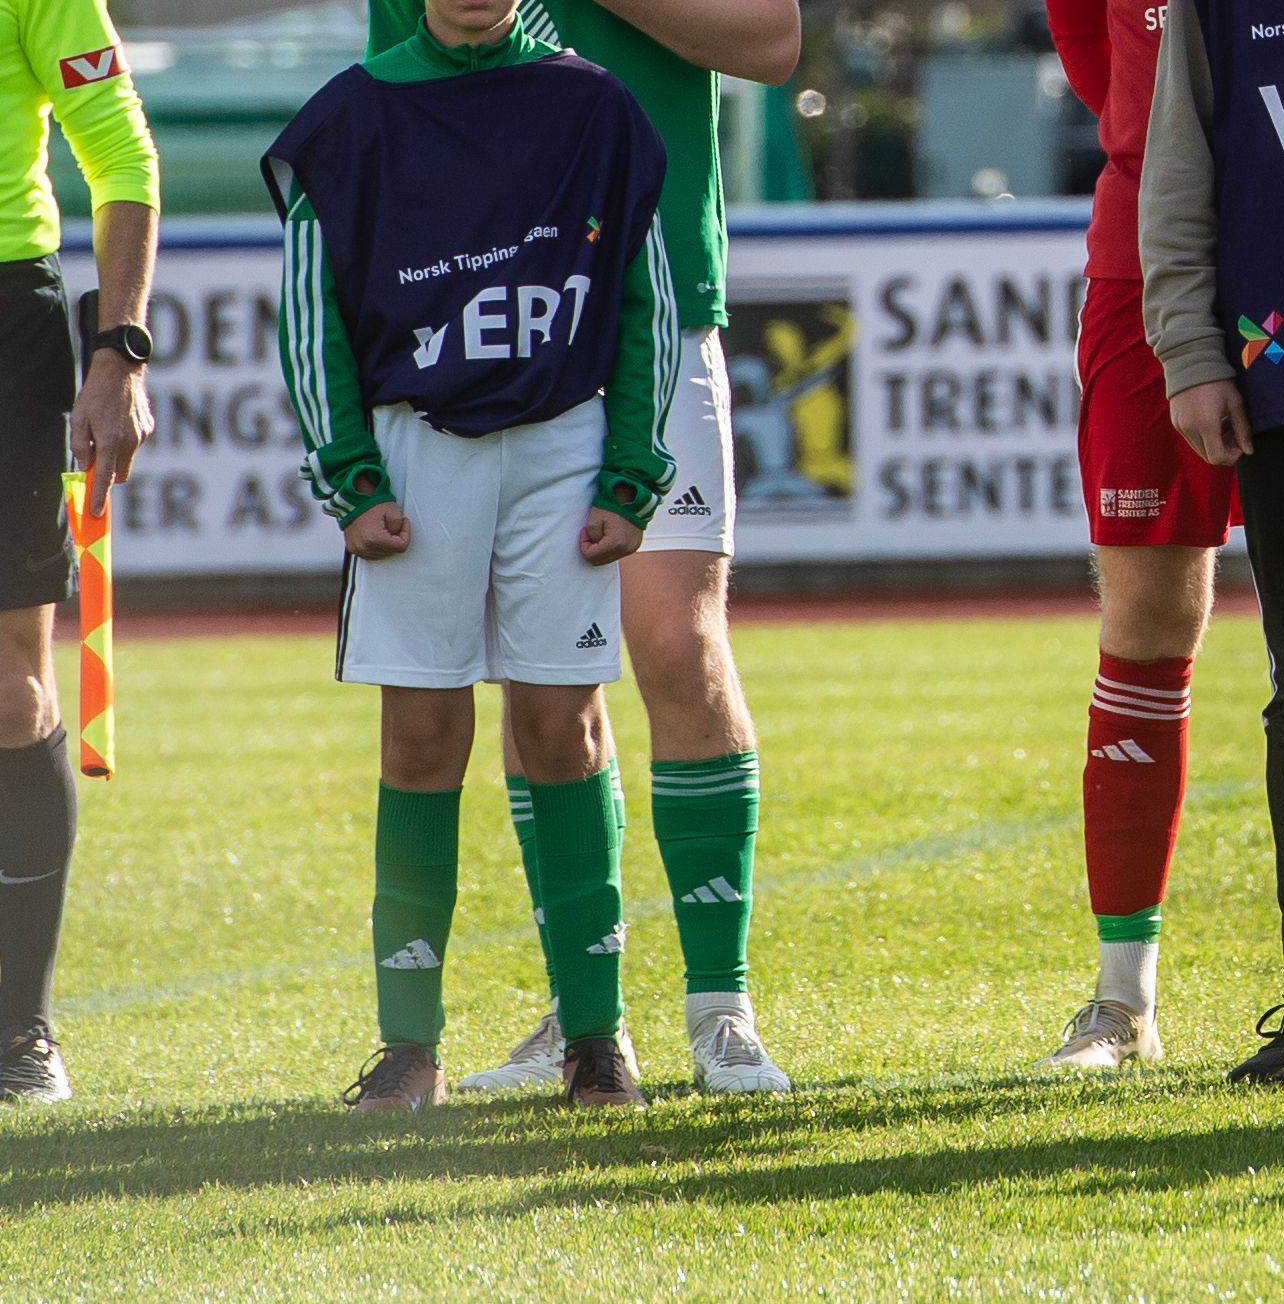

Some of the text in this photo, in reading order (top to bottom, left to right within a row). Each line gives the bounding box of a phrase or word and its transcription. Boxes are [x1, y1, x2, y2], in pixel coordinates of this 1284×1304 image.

[398, 259, 452, 285] Norsk
[877, 273, 1084, 352] SAN
[878, 456, 1077, 519] SENTE
[1117, 489, 1159, 499] SANDEN
[668, 505, 711, 516] adidas
[575, 637, 607, 649] adidas
